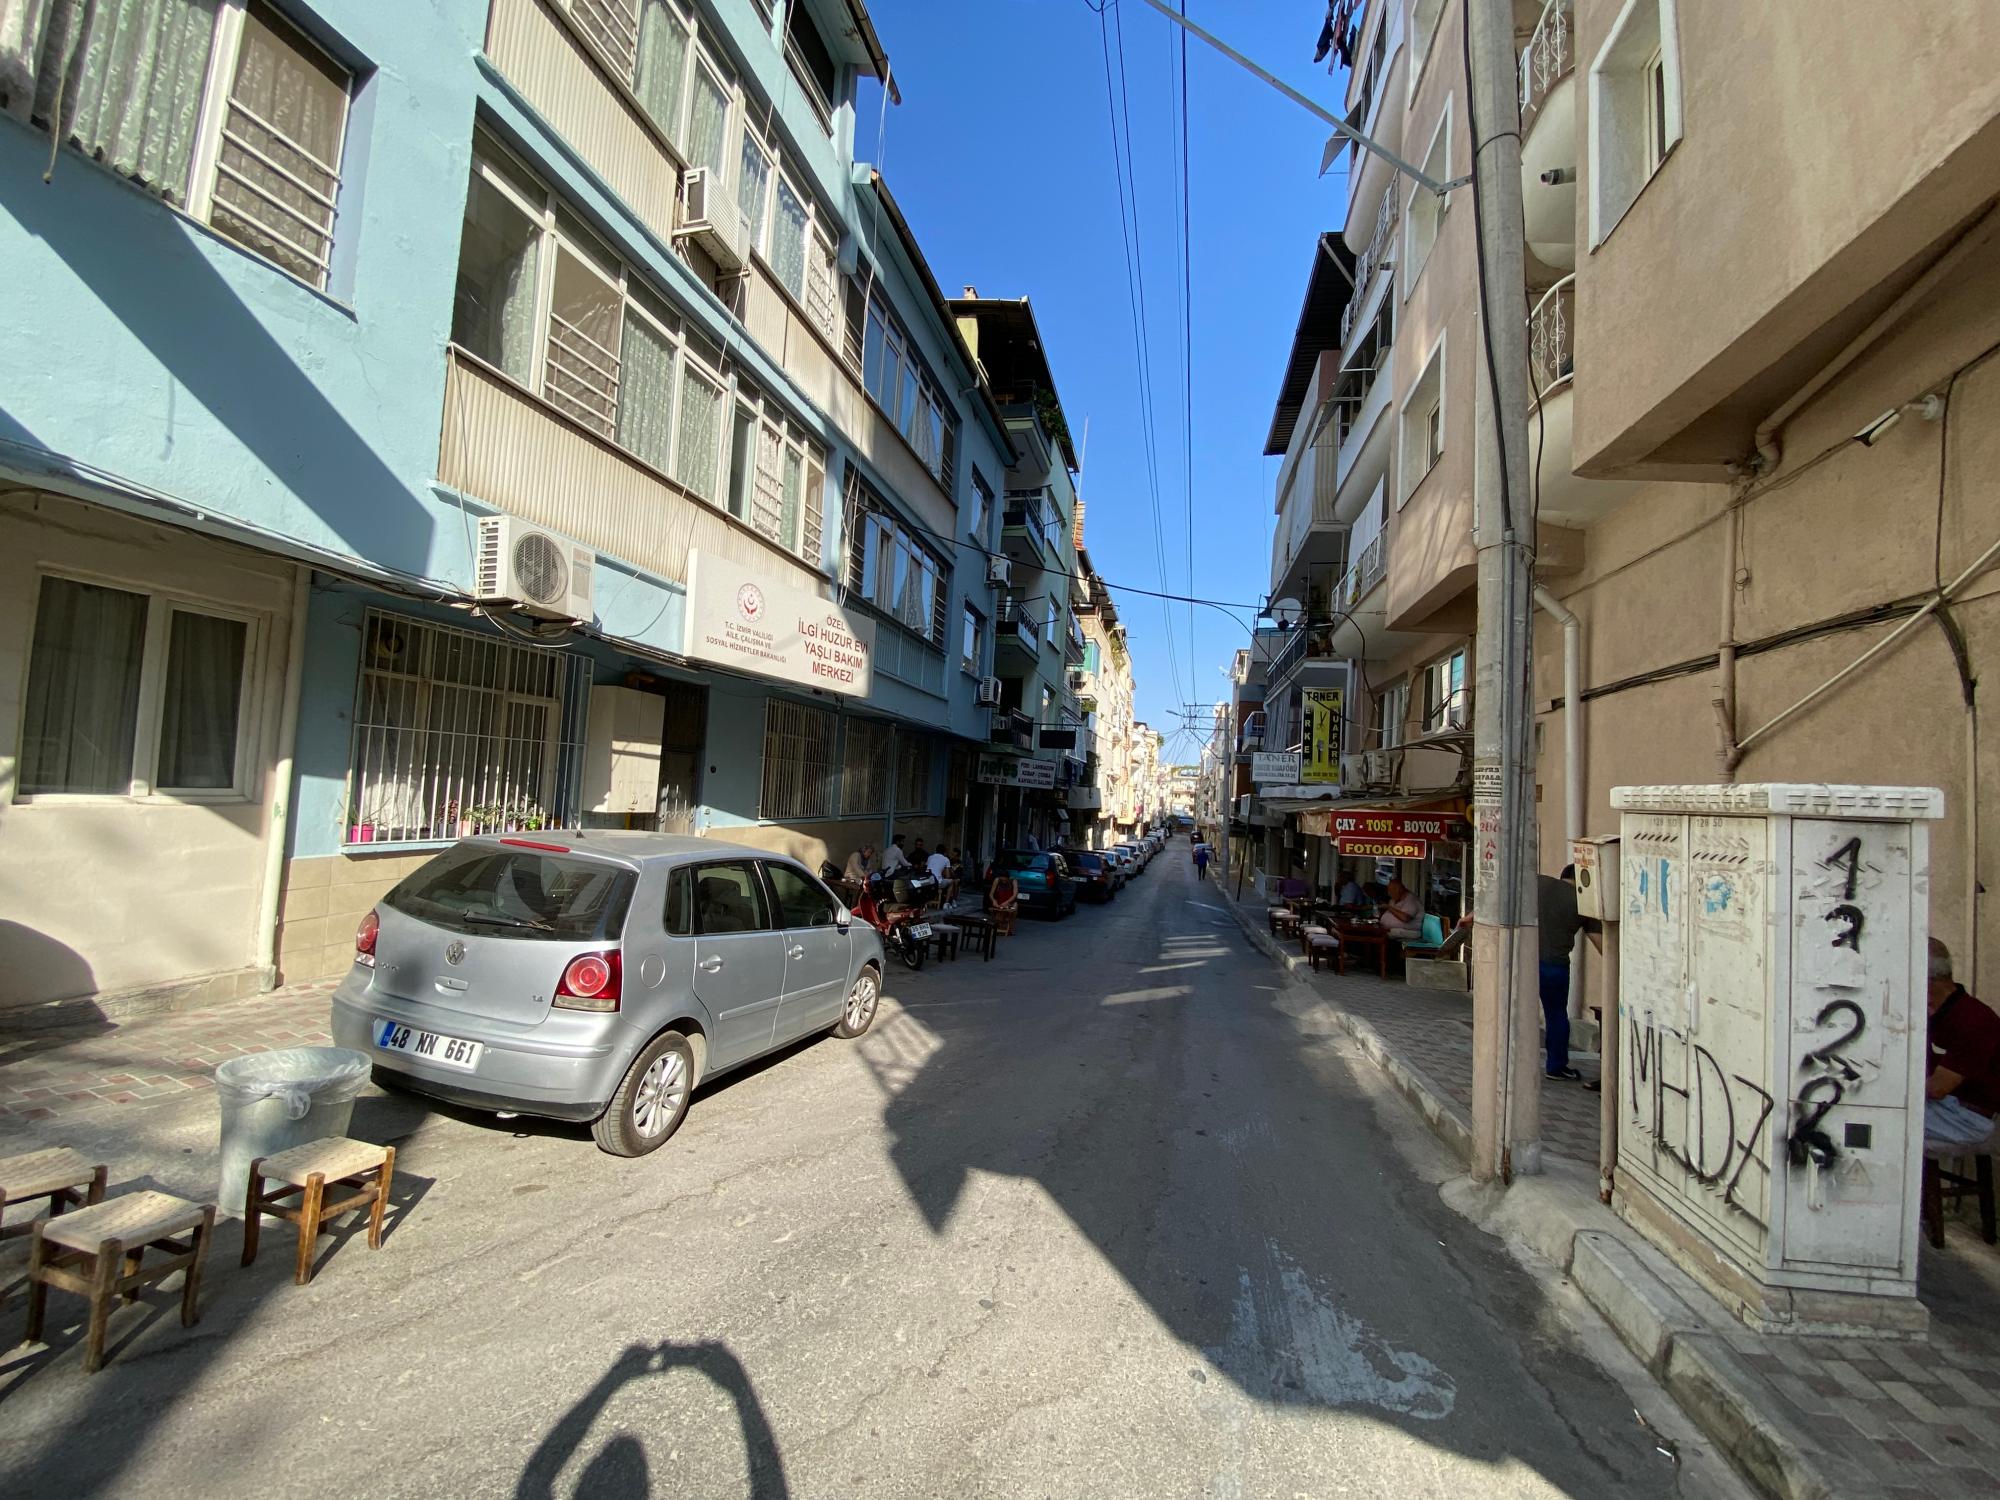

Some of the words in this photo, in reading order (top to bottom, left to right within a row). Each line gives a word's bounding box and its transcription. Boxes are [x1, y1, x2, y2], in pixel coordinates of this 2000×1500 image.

[725, 621, 735, 630] T.C.
[736, 624, 751, 634] İZMİR
[826, 614, 845, 631] ÖZEL
[741, 635, 764, 647] ÇALIŞMA
[798, 616, 818, 638] İLGİ
[820, 628, 852, 650] HUZUR
[854, 640, 868, 655] EVİ
[706, 636, 728, 648] SOSYAL
[729, 642, 759, 656] HİZMETLER
[760, 651, 787, 663] BAKANLIĞI
[804, 640, 832, 660] YAŞLI
[834, 650, 863, 669] BAKIM
[812, 661, 854, 683] MERKEZİ
[1306, 691, 1339, 701] TANER
[1335, 818, 1356, 833] ÇAY
[1366, 820, 1393, 832] TOST
[1404, 820, 1440, 834] BOYOZ
[1345, 843, 1419, 856] FOTOKOPİ
[390, 1026, 411, 1049] 48
[415, 1032, 439, 1056] NN
[444, 1040, 476, 1064] 661
